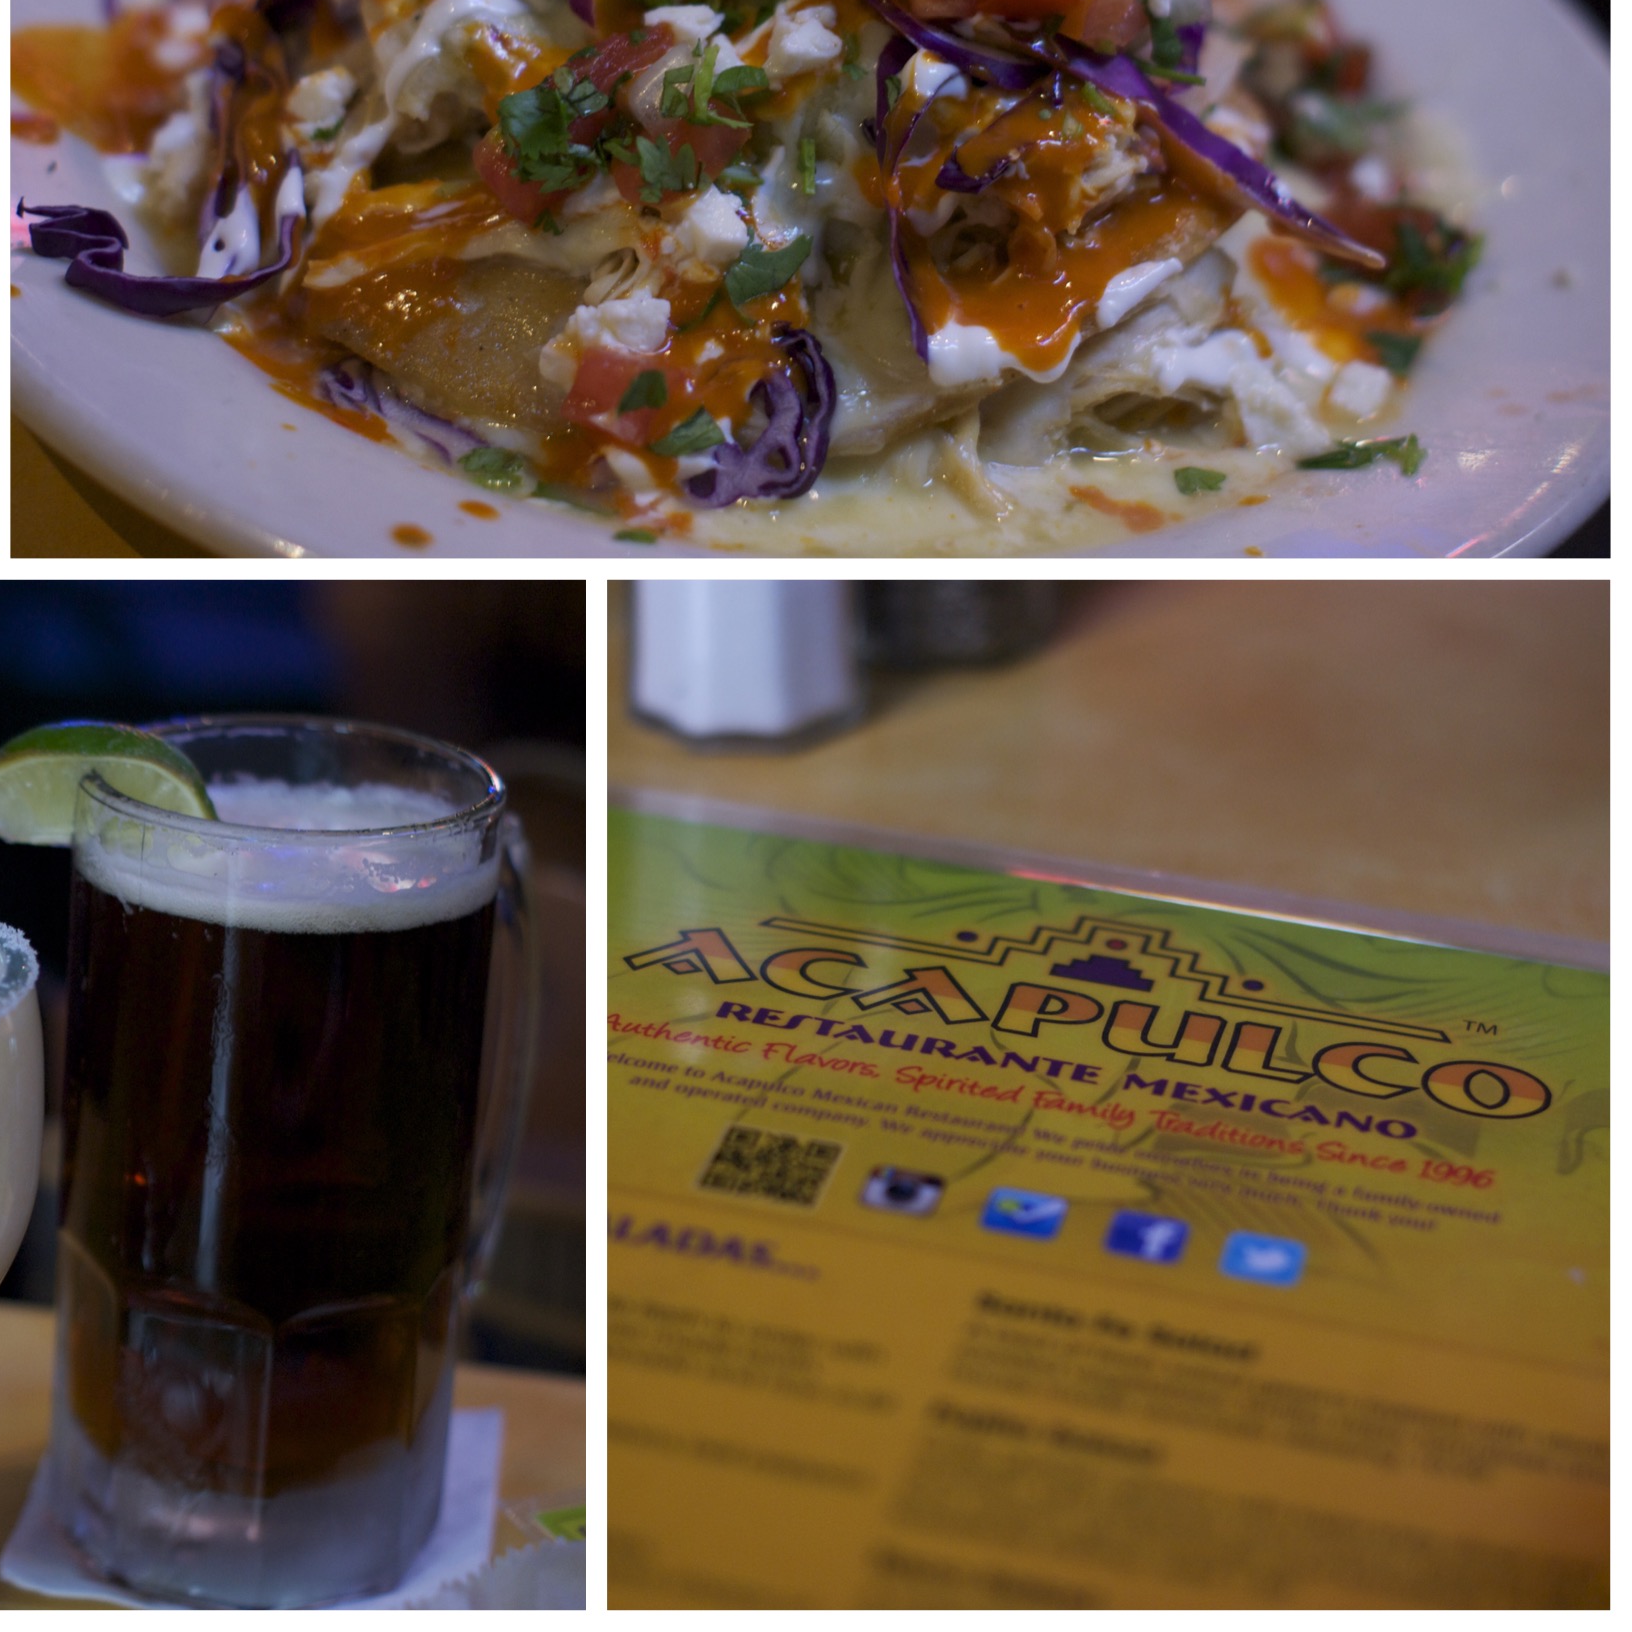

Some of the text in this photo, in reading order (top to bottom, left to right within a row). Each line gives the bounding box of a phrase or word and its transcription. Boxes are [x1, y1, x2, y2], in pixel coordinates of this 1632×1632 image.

[607, 1051, 678, 1076] elcome
[684, 1065, 706, 1080] to
[711, 1070, 806, 1097] Acapulco
[813, 1088, 899, 1114] Mexican
[623, 927, 1553, 1120] ACAPULCO
[628, 1074, 671, 1092] and
[674, 1083, 769, 1109] operated
[716, 1001, 1417, 1139] RESTAURANTE MEXICANO
[607, 1013, 752, 1054] Authentic
[896, 1065, 1025, 1103] Spirited
[1033, 1090, 1136, 1130] Family
[1149, 1109, 1305, 1155] Traditions
[1316, 1139, 1409, 1174] Since
[1418, 1159, 1497, 1189] 1996
